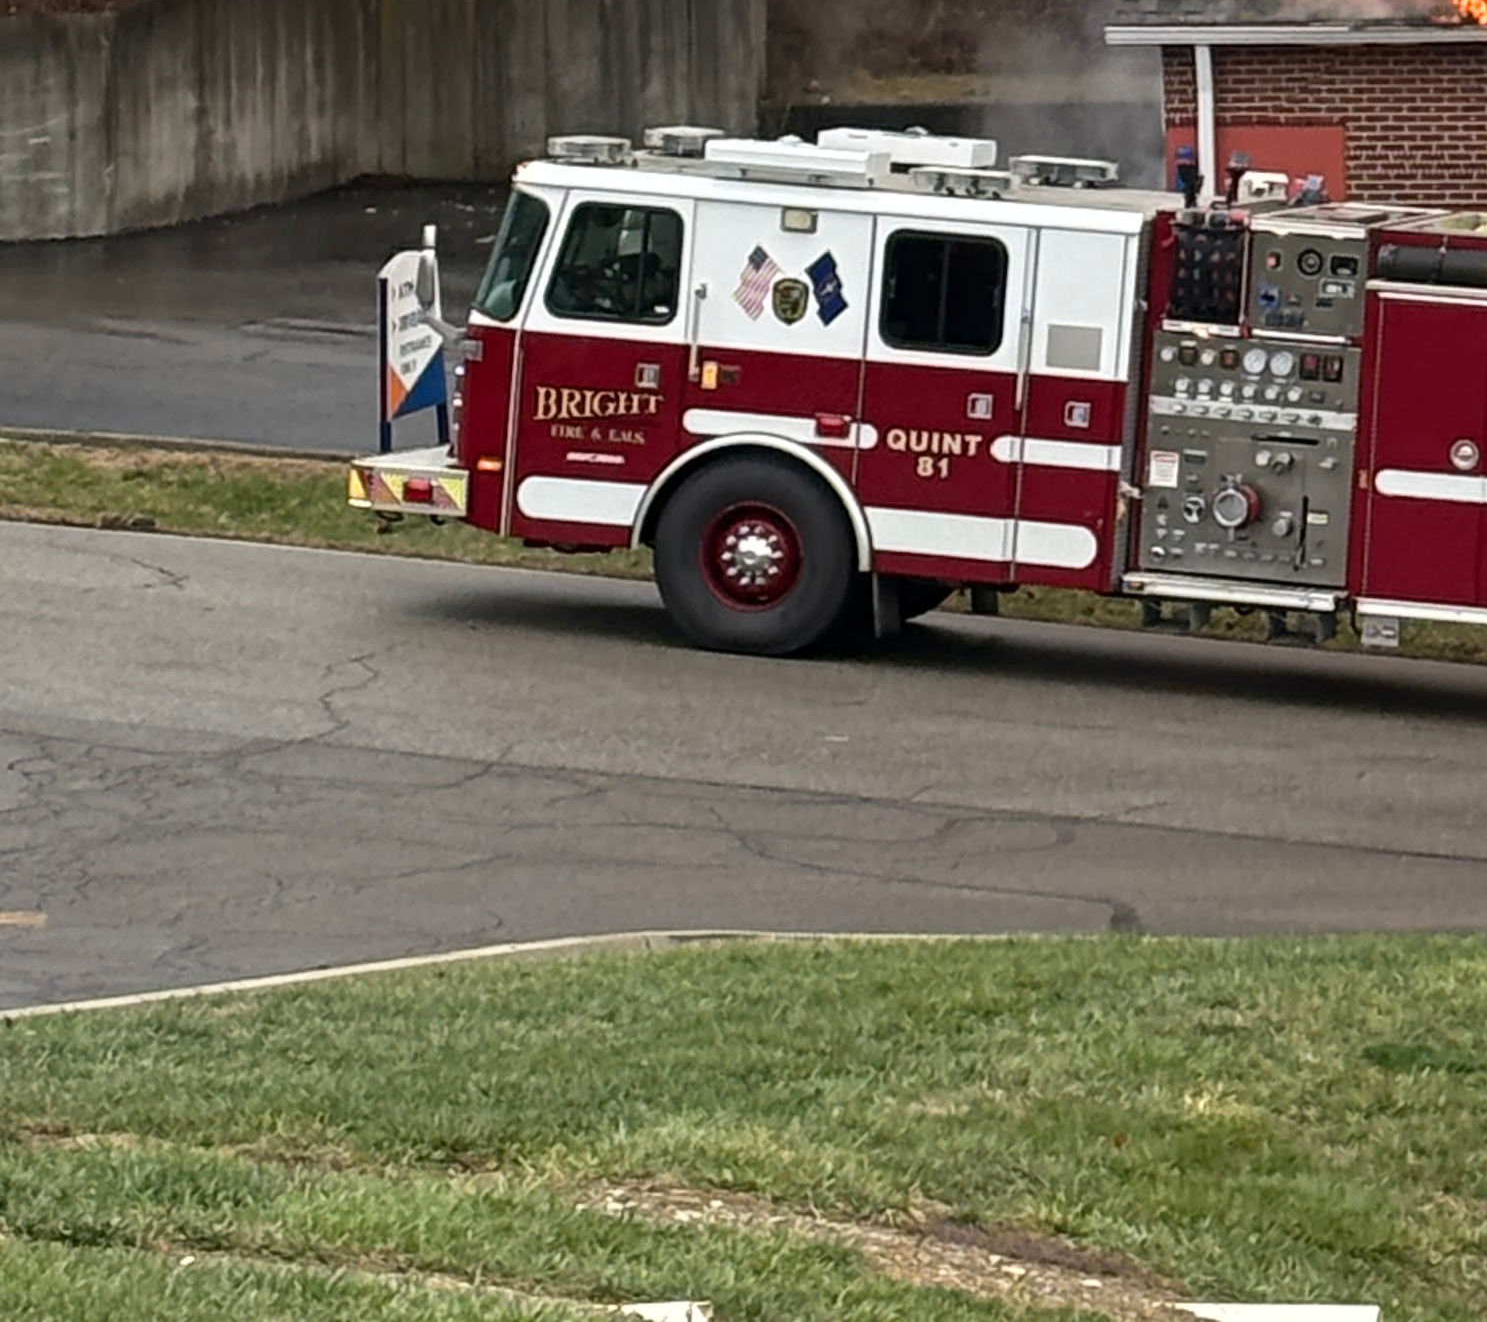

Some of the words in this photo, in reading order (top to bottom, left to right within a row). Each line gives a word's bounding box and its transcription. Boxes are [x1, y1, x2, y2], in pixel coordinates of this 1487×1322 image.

[533, 385, 665, 420] BRIGHT
[550, 424, 584, 439] FIRE
[886, 428, 983, 456] QUINT
[917, 456, 949, 478] 81
